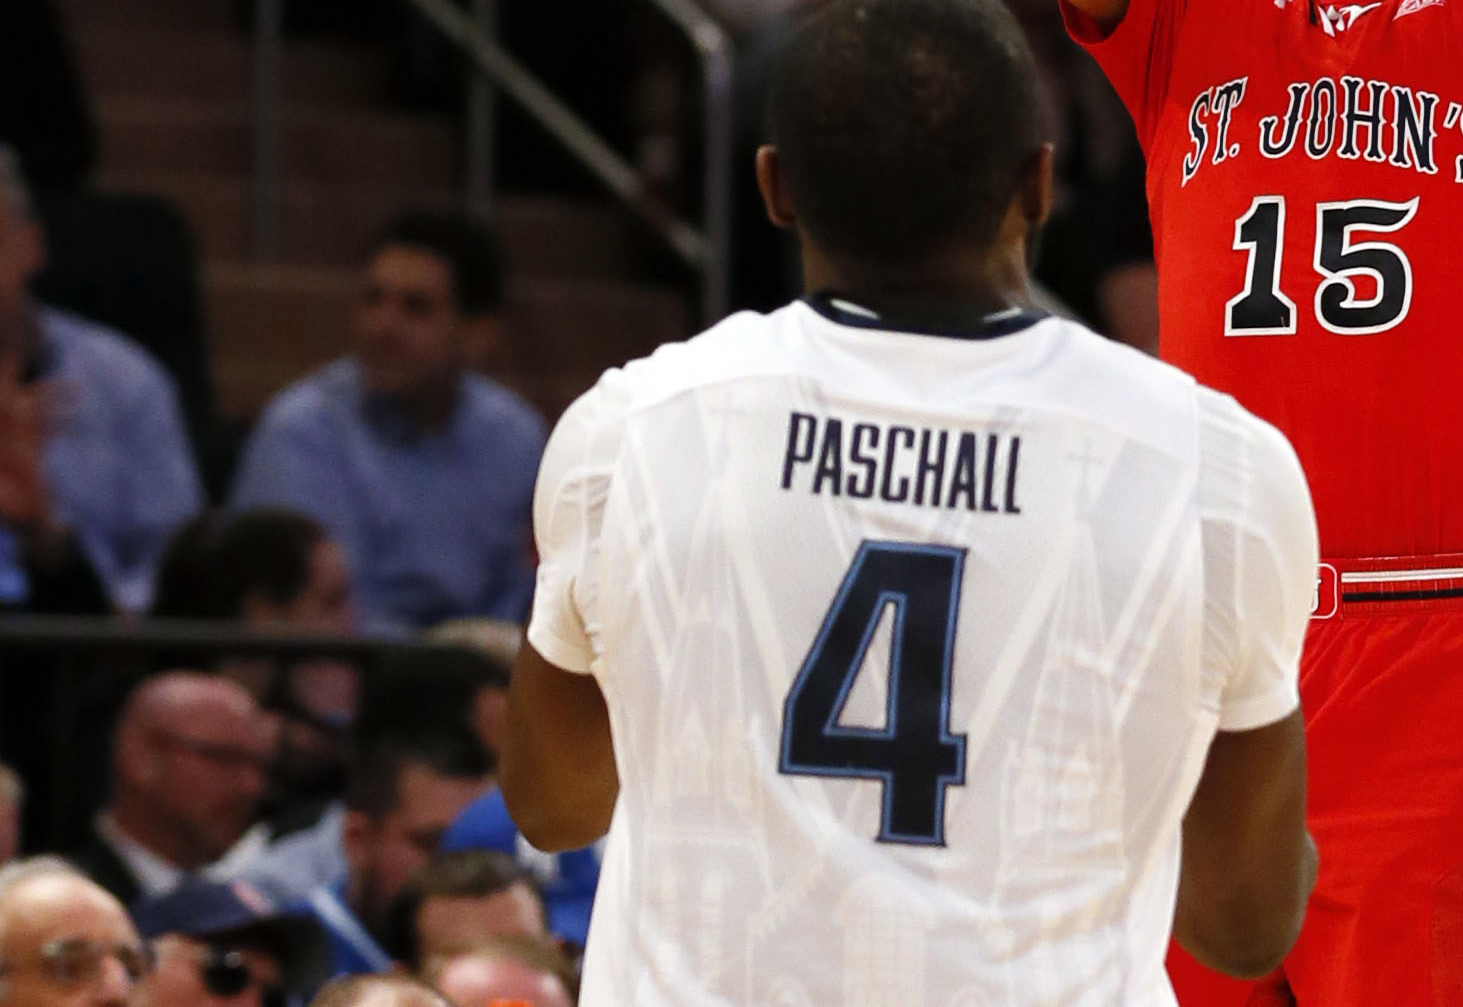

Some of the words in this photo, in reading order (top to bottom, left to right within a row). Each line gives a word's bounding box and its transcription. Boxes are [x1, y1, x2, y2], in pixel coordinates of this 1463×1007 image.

[1181, 76, 1249, 188] ST.
[1224, 195, 1420, 336] 15
[781, 412, 1021, 514] PASCHALL
[778, 539, 968, 847] 4
